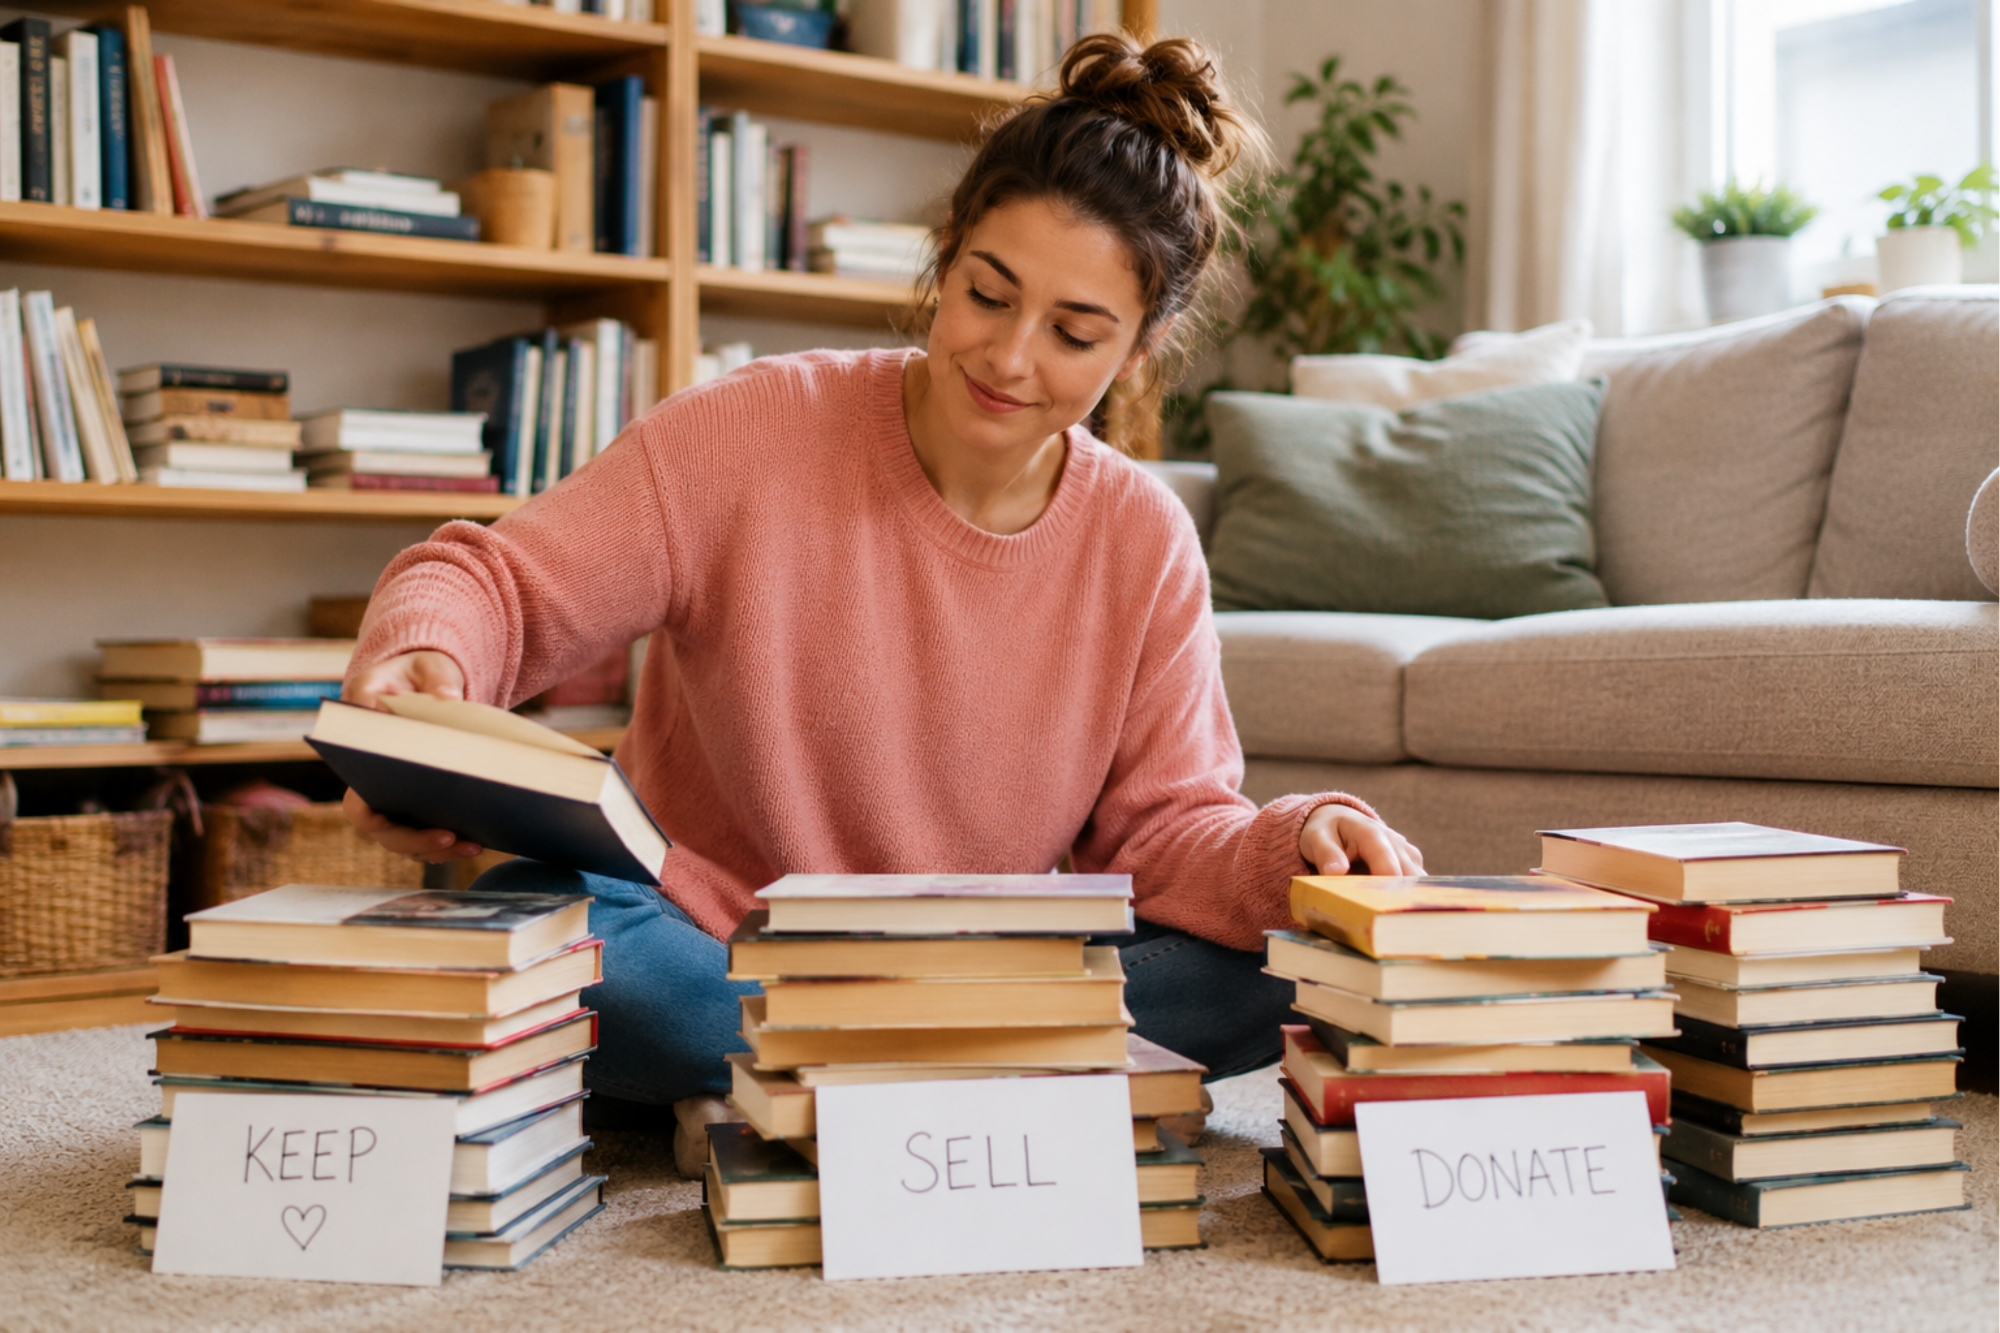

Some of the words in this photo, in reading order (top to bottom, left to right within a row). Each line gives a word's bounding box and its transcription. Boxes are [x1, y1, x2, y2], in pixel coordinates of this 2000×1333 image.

[243, 1125, 378, 1184] KEEP
[900, 1131, 1057, 1194] SELL
[1411, 1145, 1617, 1209] DONATE
